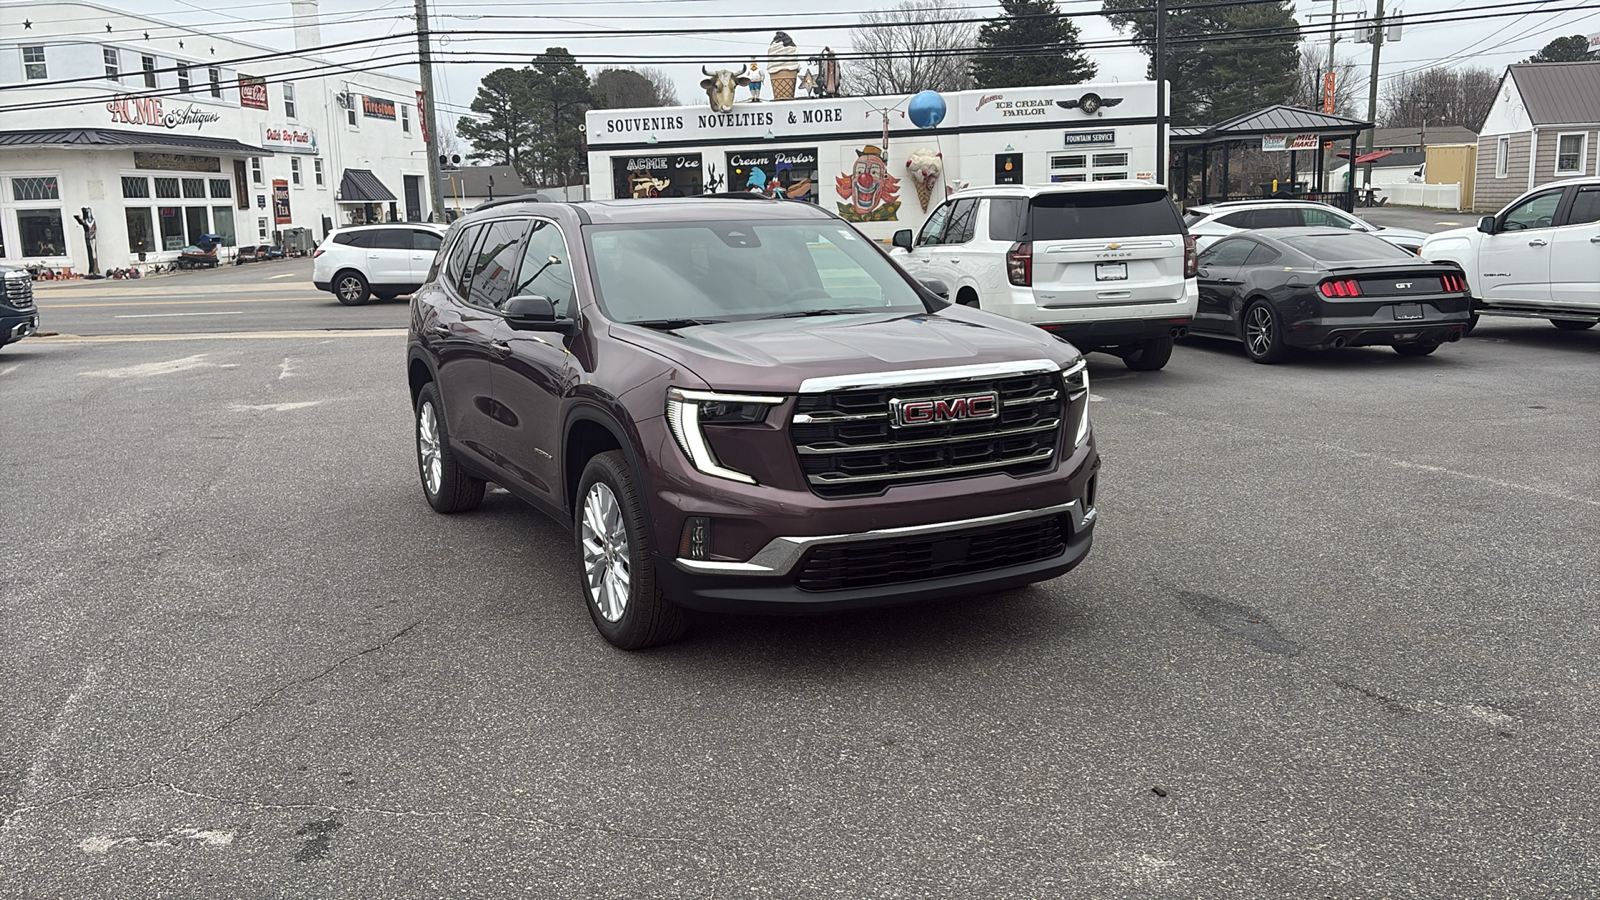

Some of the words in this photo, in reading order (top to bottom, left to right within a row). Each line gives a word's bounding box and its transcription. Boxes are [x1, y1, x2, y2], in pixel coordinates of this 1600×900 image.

[106, 92, 166, 128] ACME
[164, 103, 221, 131] Antiques
[995, 101, 1012, 110] ICE
[1014, 99, 1054, 108] CREAM
[1002, 108, 1046, 117] PARLOR
[607, 116, 684, 133] SOUVENIRS
[698, 112, 774, 129] NOVELTIES
[787, 111, 797, 124] &
[802, 108, 843, 124] MORE
[266, 128, 281, 141] Dutch
[282, 130, 293, 145] Boy
[293, 130, 309, 144] Paints
[1066, 133, 1091, 143] FOUNTAIN
[1092, 132, 1113, 141] SERVICE
[627, 157, 668, 170] ACME
[675, 157, 699, 168] Ice
[730, 154, 769, 167] Cream
[774, 152, 815, 165] Parlor
[277, 204, 289, 216] TEA
[903, 396, 995, 423] GMC
